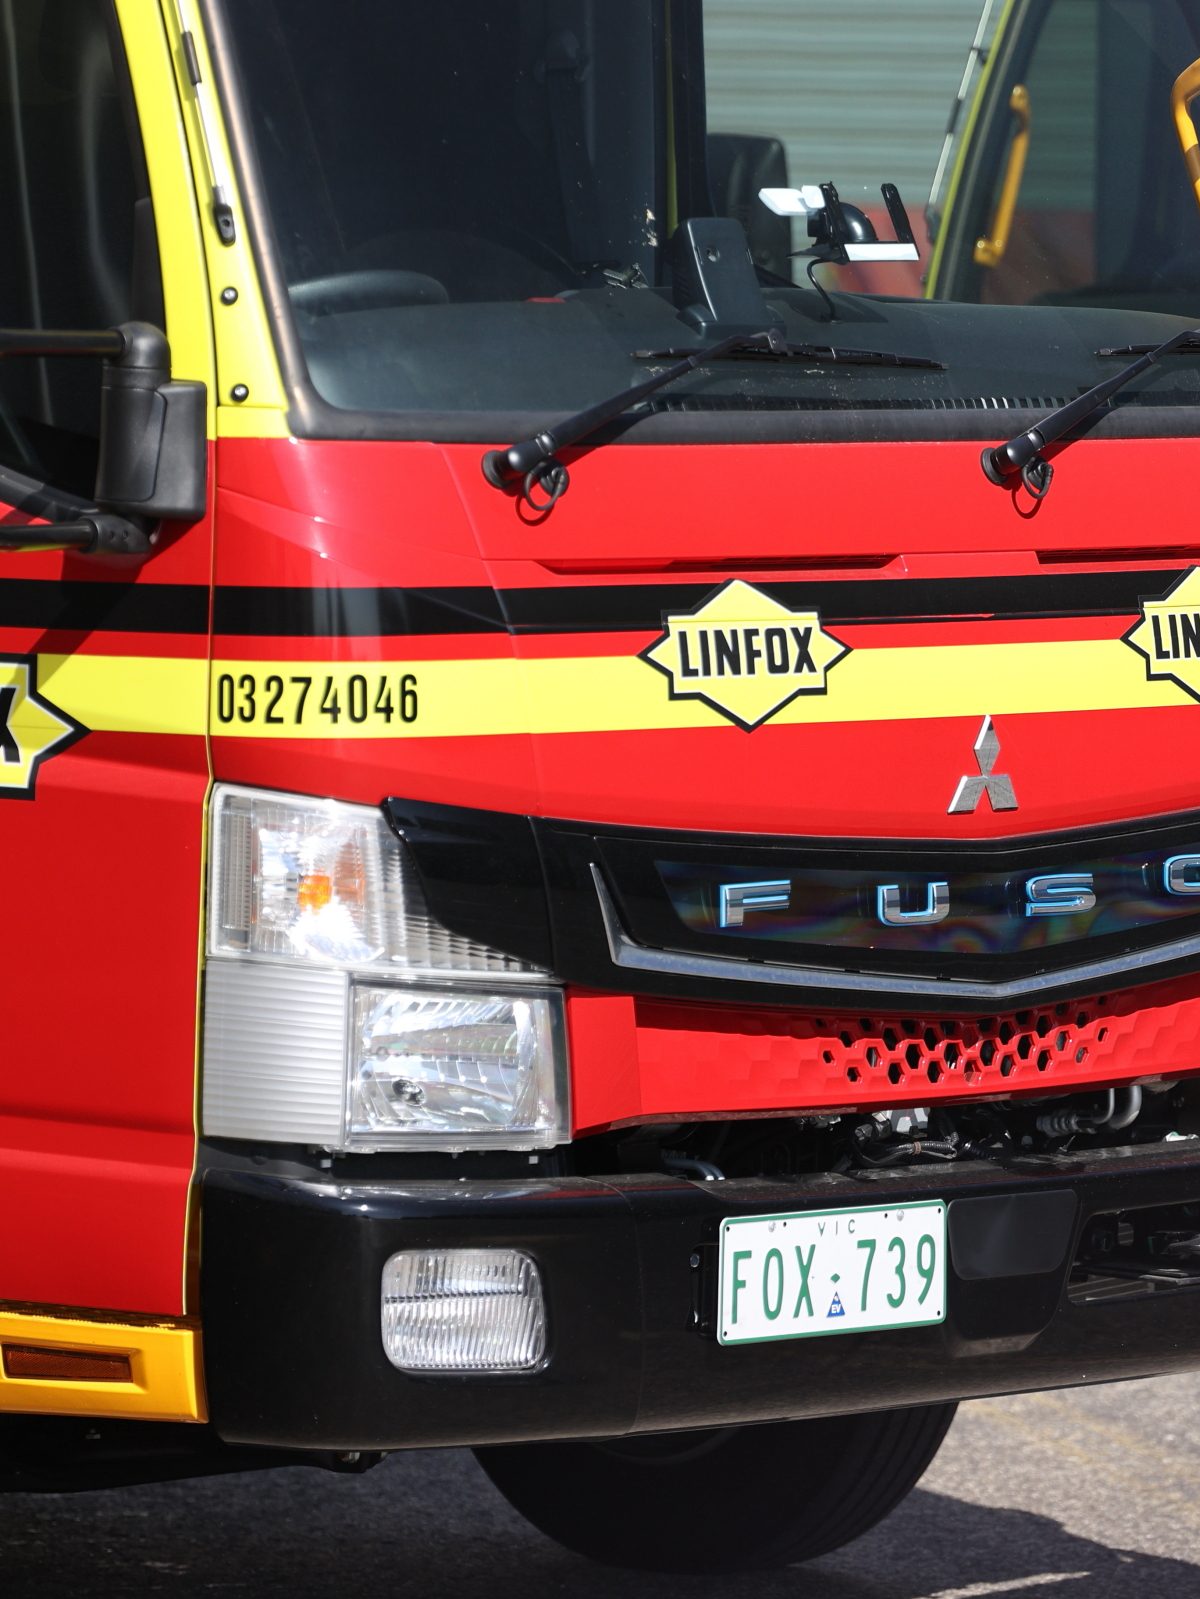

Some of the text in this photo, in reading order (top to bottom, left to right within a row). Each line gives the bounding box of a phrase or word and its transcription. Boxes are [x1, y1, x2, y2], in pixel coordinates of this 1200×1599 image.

[678, 626, 818, 677] LINFOX
[218, 674, 418, 724] 03274046
[818, 1219, 856, 1236] VIC
[856, 1233, 937, 1312] 739
[831, 1304, 842, 1314] EV
